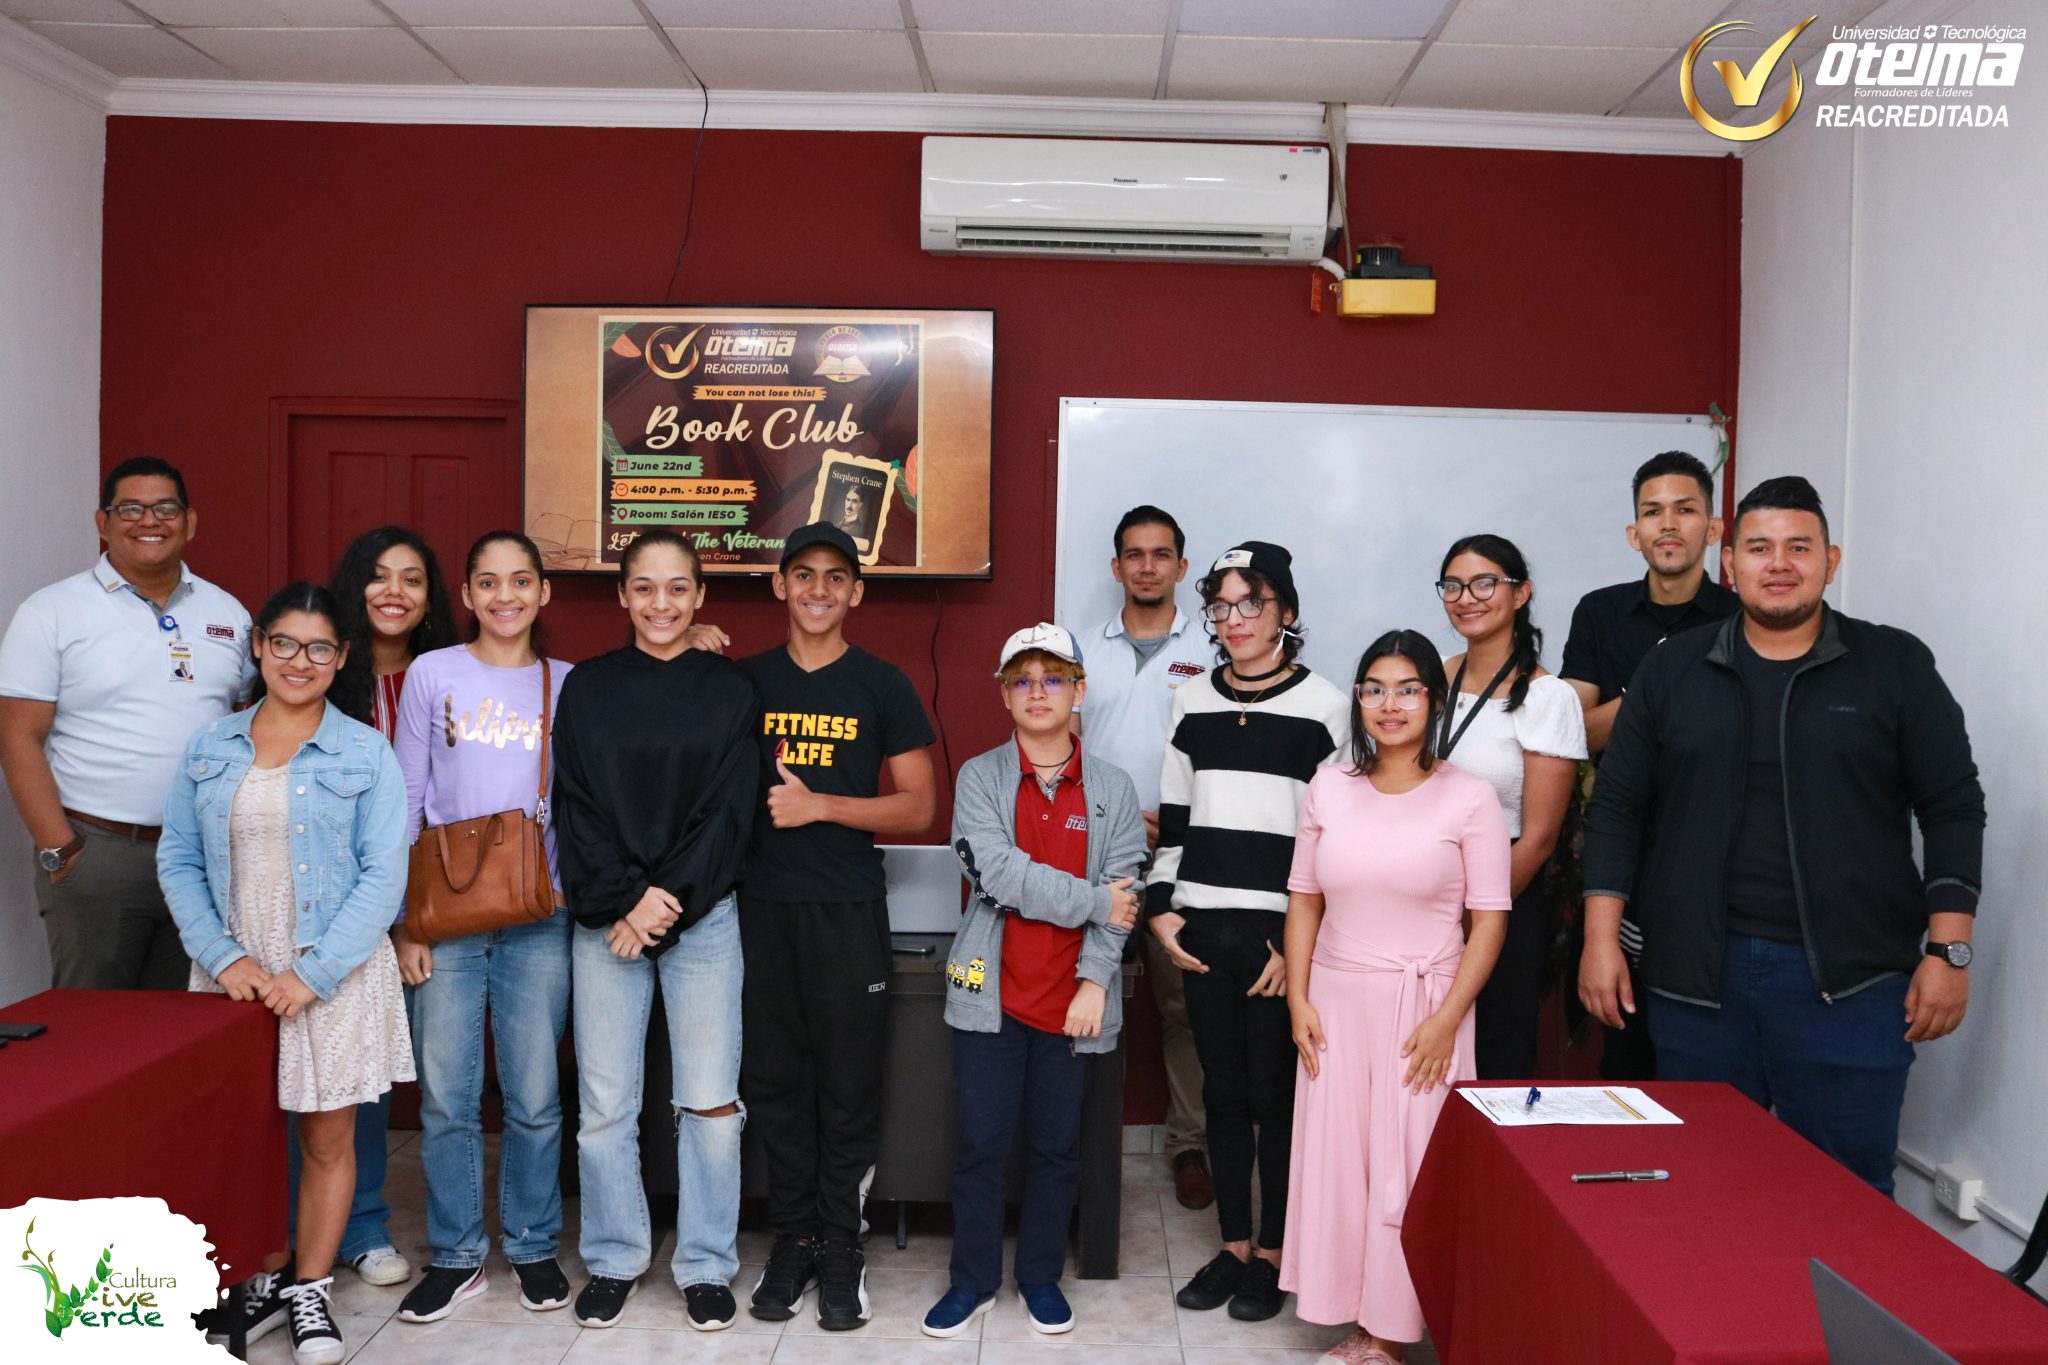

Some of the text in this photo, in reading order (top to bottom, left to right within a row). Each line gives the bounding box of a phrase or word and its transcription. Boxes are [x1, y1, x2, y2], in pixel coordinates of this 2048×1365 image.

[711, 328, 798, 337] Universidad Tecnológica
[704, 363, 789, 375] REACREDITADA
[705, 388, 816, 397] You can not lose this!
[645, 402, 865, 450] Book Club
[630, 461, 692, 471] June 22nd
[832, 469, 883, 489] Stephen Crane
[630, 485, 656, 494] 4:00
[659, 487, 685, 496] p.m.
[695, 486, 720, 495] 5:30
[722, 488, 748, 497] p.m.
[630, 509, 736, 519] Room: Salón IESO
[690, 531, 720, 550] The
[723, 530, 786, 551] Veteran
[713, 553, 741, 561] Crane
[764, 712, 858, 741] FITNESS
[781, 741, 834, 767] LIFE
